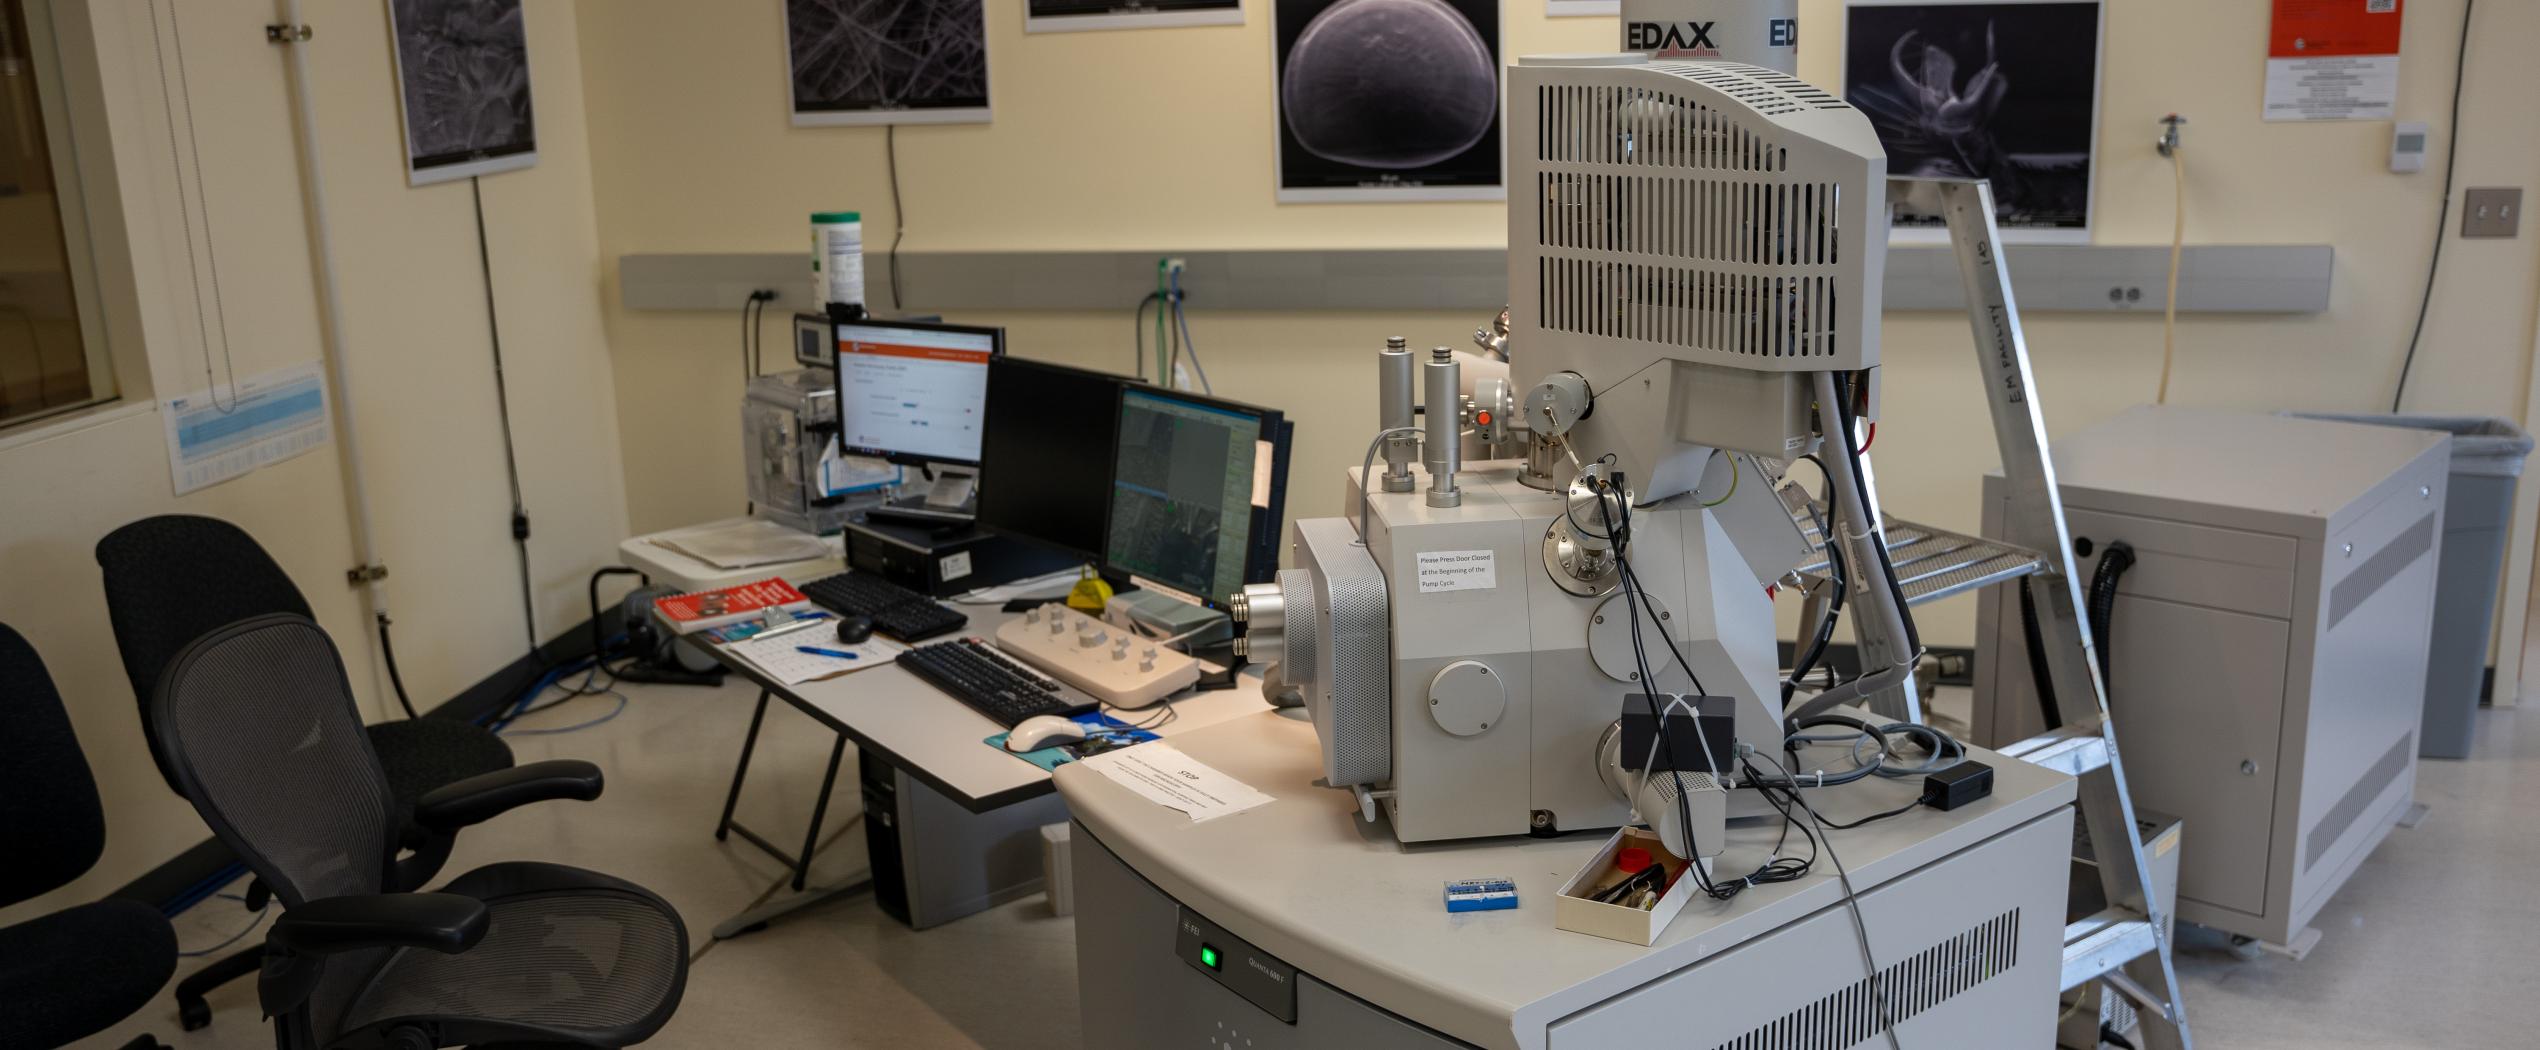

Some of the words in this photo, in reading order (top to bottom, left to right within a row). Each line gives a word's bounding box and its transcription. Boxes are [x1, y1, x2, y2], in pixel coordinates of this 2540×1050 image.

[1628, 22, 1715, 49] EDAX
[2005, 375, 2023, 404] EM
[1439, 567, 1468, 575] Beginning
[1178, 770, 1199, 780] STOP
[1249, 958, 1269, 975] QUANTA
